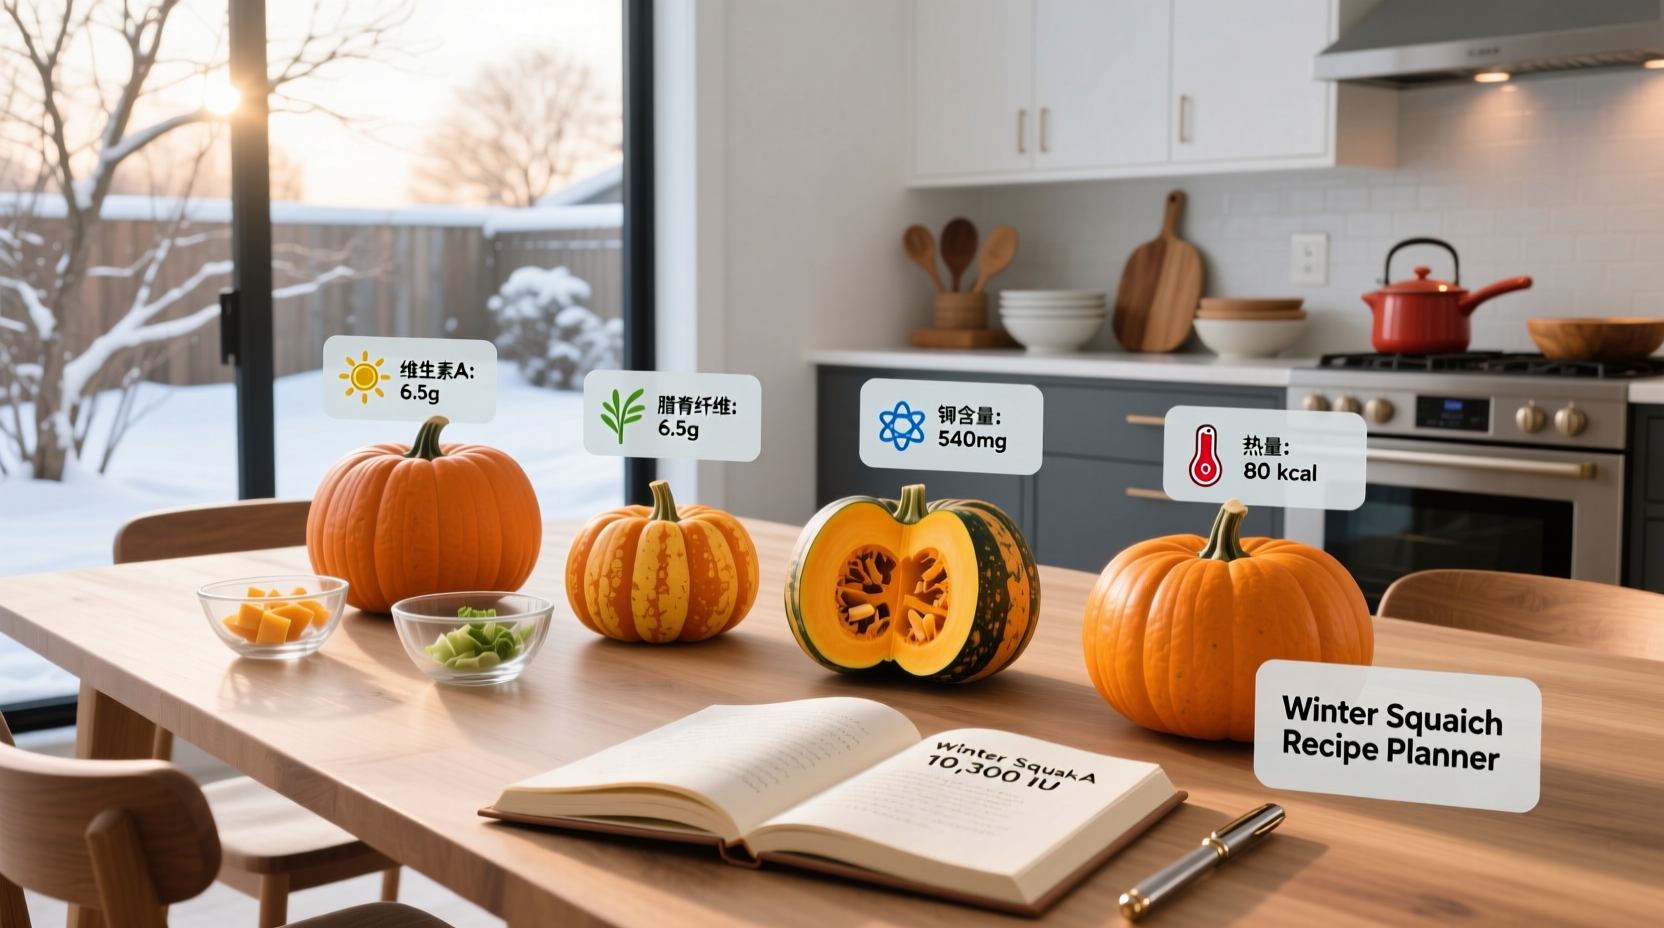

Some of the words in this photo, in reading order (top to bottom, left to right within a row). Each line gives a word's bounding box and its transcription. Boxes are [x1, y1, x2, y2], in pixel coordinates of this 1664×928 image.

[936, 741, 1007, 763] Winter
[928, 755, 1021, 783] 10,300
[1027, 776, 1061, 791] IU
